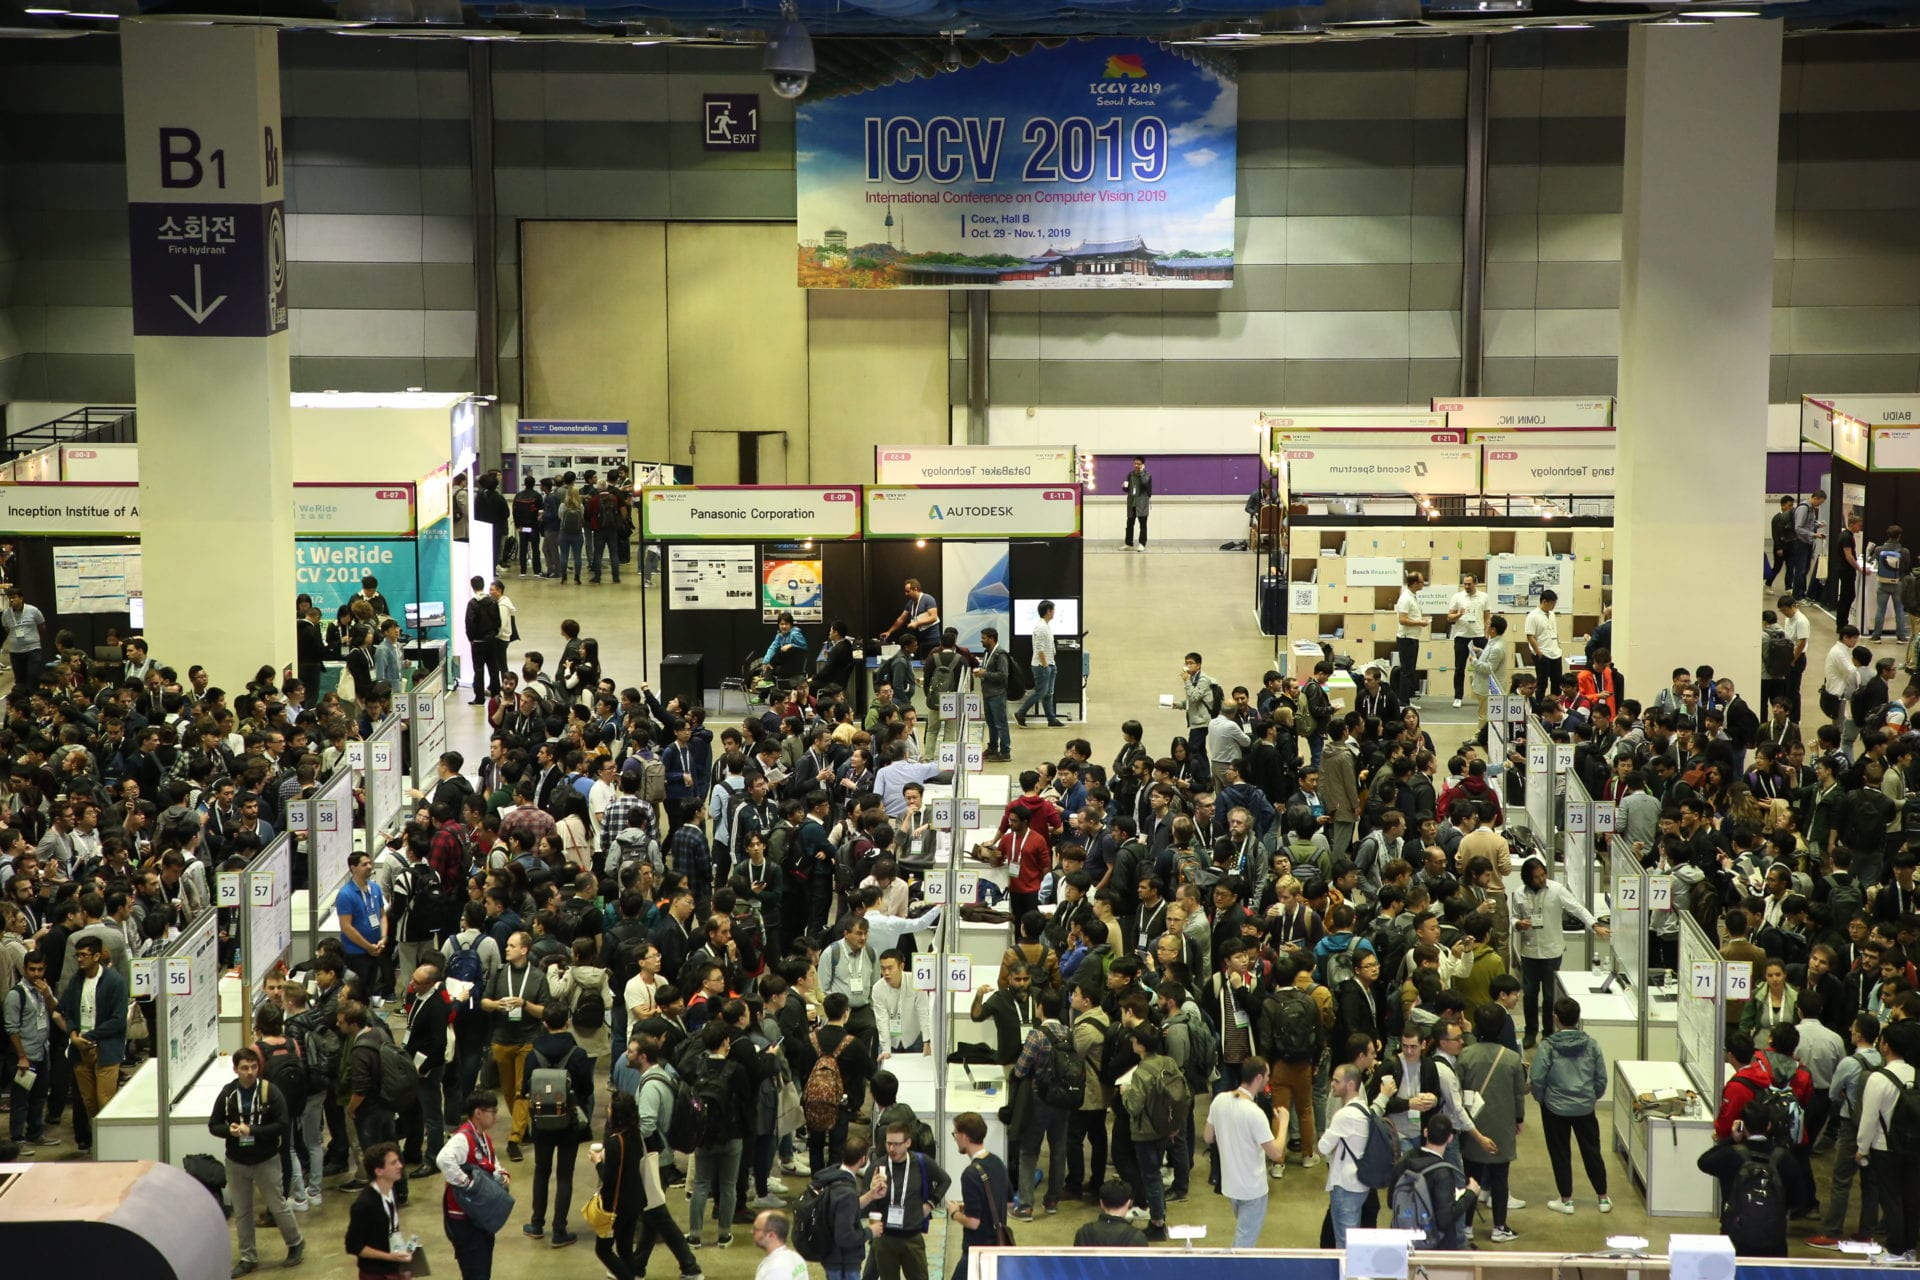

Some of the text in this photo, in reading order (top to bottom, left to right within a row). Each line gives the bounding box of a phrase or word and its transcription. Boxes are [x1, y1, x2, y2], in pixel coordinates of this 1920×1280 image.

[1089, 82, 1161, 94] ICCV 2019
[748, 108, 757, 131] 1
[733, 134, 757, 144] EXIT
[864, 116, 1168, 183] ICCV 2019
[159, 127, 226, 189] B1
[264, 126, 279, 187] B1
[865, 190, 1166, 205] International Conference on Computer Vision 2019
[971, 214, 1030, 225] Coex, Hall B
[157, 215, 236, 243] 소화전
[971, 229, 991, 238] Oct.
[994, 229, 1006, 238] 29
[1048, 228, 1071, 238] 2019
[168, 245, 226, 255] Fire hydrant
[549, 424, 598, 432] Demonstration
[602, 424, 608, 432] 3
[8, 505, 62, 518] Inception
[66, 505, 110, 517] Institue
[114, 506, 127, 517] of
[299, 504, 338, 513] WeRide
[946, 506, 1014, 517] AUTODESK
[690, 508, 815, 521] Panasonic Corporation
[309, 545, 393, 564] WeRide
[396, 703, 406, 712] 55
[420, 703, 430, 711] 60
[943, 703, 954, 712] 65
[967, 702, 978, 712] 70
[1491, 706, 1501, 714] 75
[1511, 706, 1521, 714] 80
[350, 752, 361, 763] 54
[376, 752, 386, 762] 59
[943, 754, 954, 763] 64
[968, 755, 979, 763] 69
[1534, 756, 1543, 764] 74
[1560, 756, 1570, 764] 79
[292, 811, 304, 822] 53
[321, 811, 332, 822] 58
[936, 811, 948, 820] 63
[964, 811, 976, 820] 68
[1571, 814, 1582, 823] 73
[1599, 815, 1610, 824] 78
[223, 887, 235, 897] 52
[255, 886, 267, 896] 57
[929, 884, 941, 894] 62
[960, 884, 972, 894] 67
[1623, 890, 1635, 899] 72
[1654, 890, 1666, 899] 77
[171, 973, 185, 984] 56
[918, 969, 930, 979] 61
[952, 970, 965, 980] 66
[136, 974, 149, 985] 51
[1697, 976, 1709, 986] 71
[1732, 978, 1745, 988] 76
